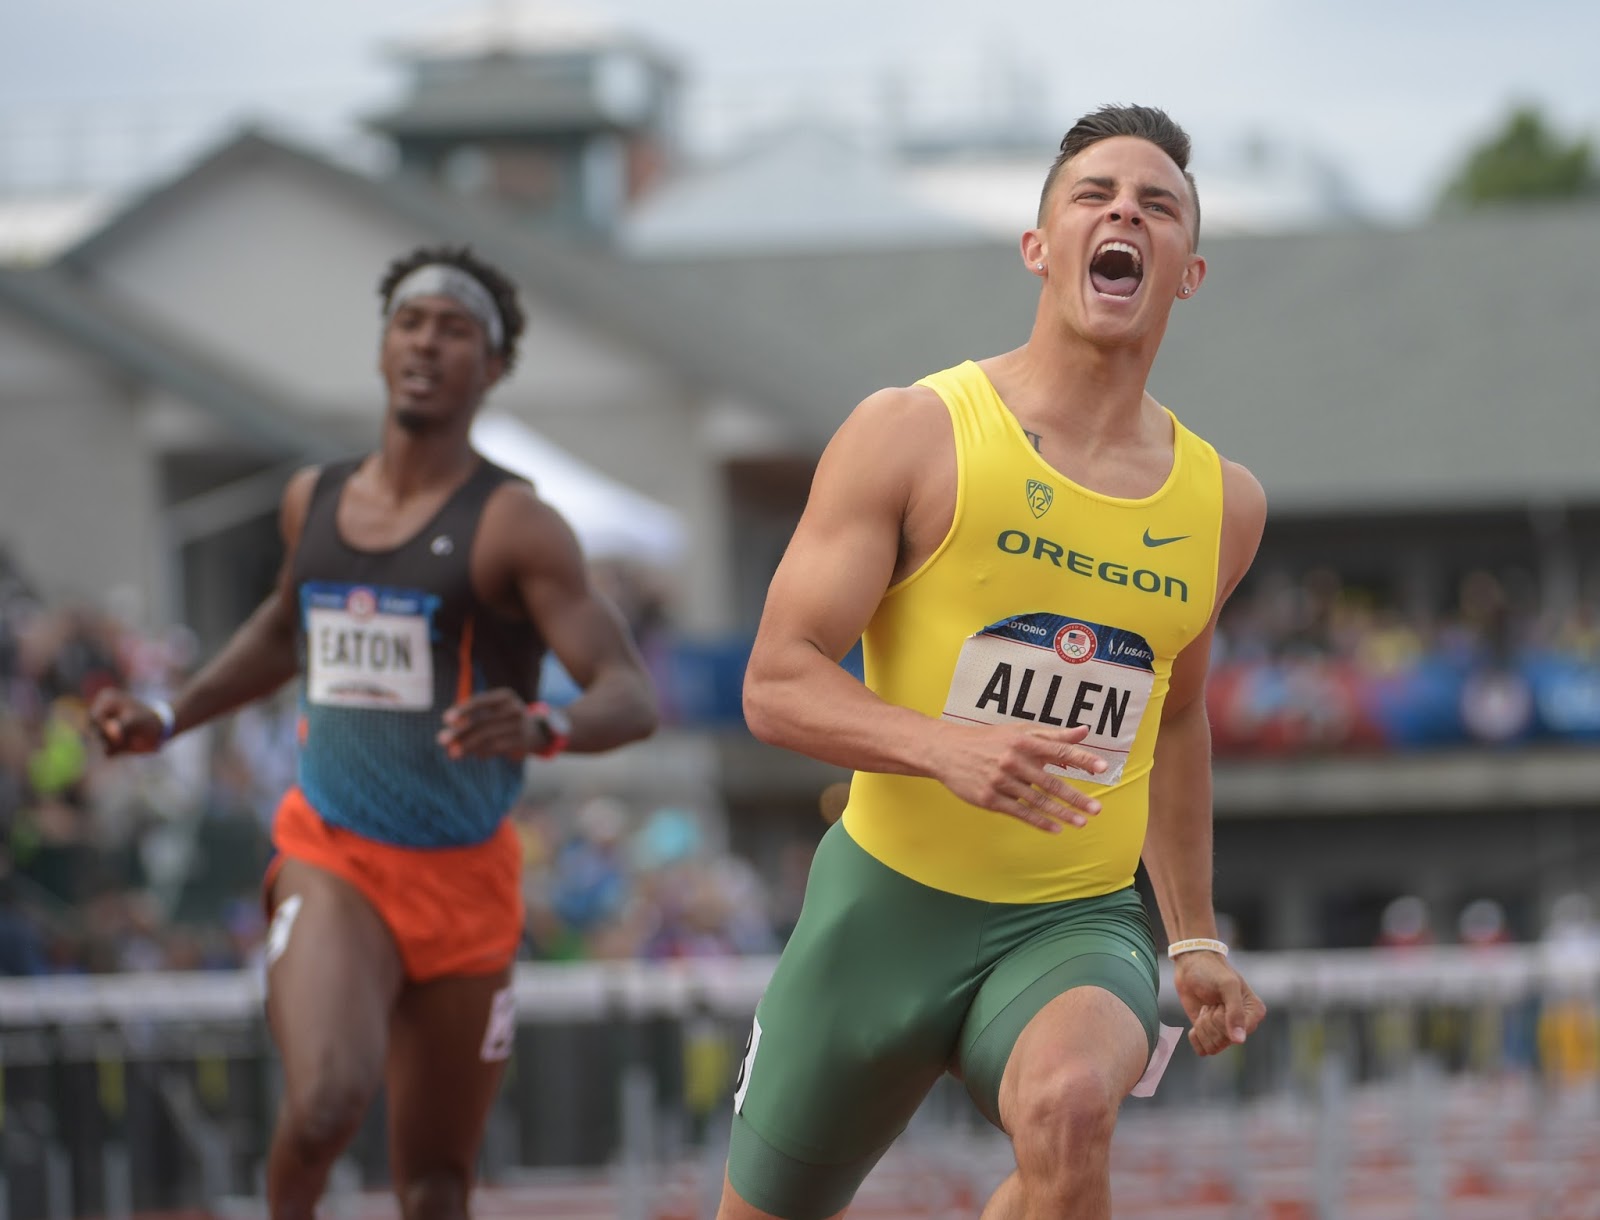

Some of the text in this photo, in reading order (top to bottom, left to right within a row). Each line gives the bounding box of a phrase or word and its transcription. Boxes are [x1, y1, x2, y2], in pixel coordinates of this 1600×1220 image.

[1032, 495, 1046, 512] 12
[996, 529, 1188, 603] OREGON
[320, 626, 412, 672] EATON
[1007, 621, 1047, 636] DTORIO
[975, 662, 1131, 738] ALLEN
